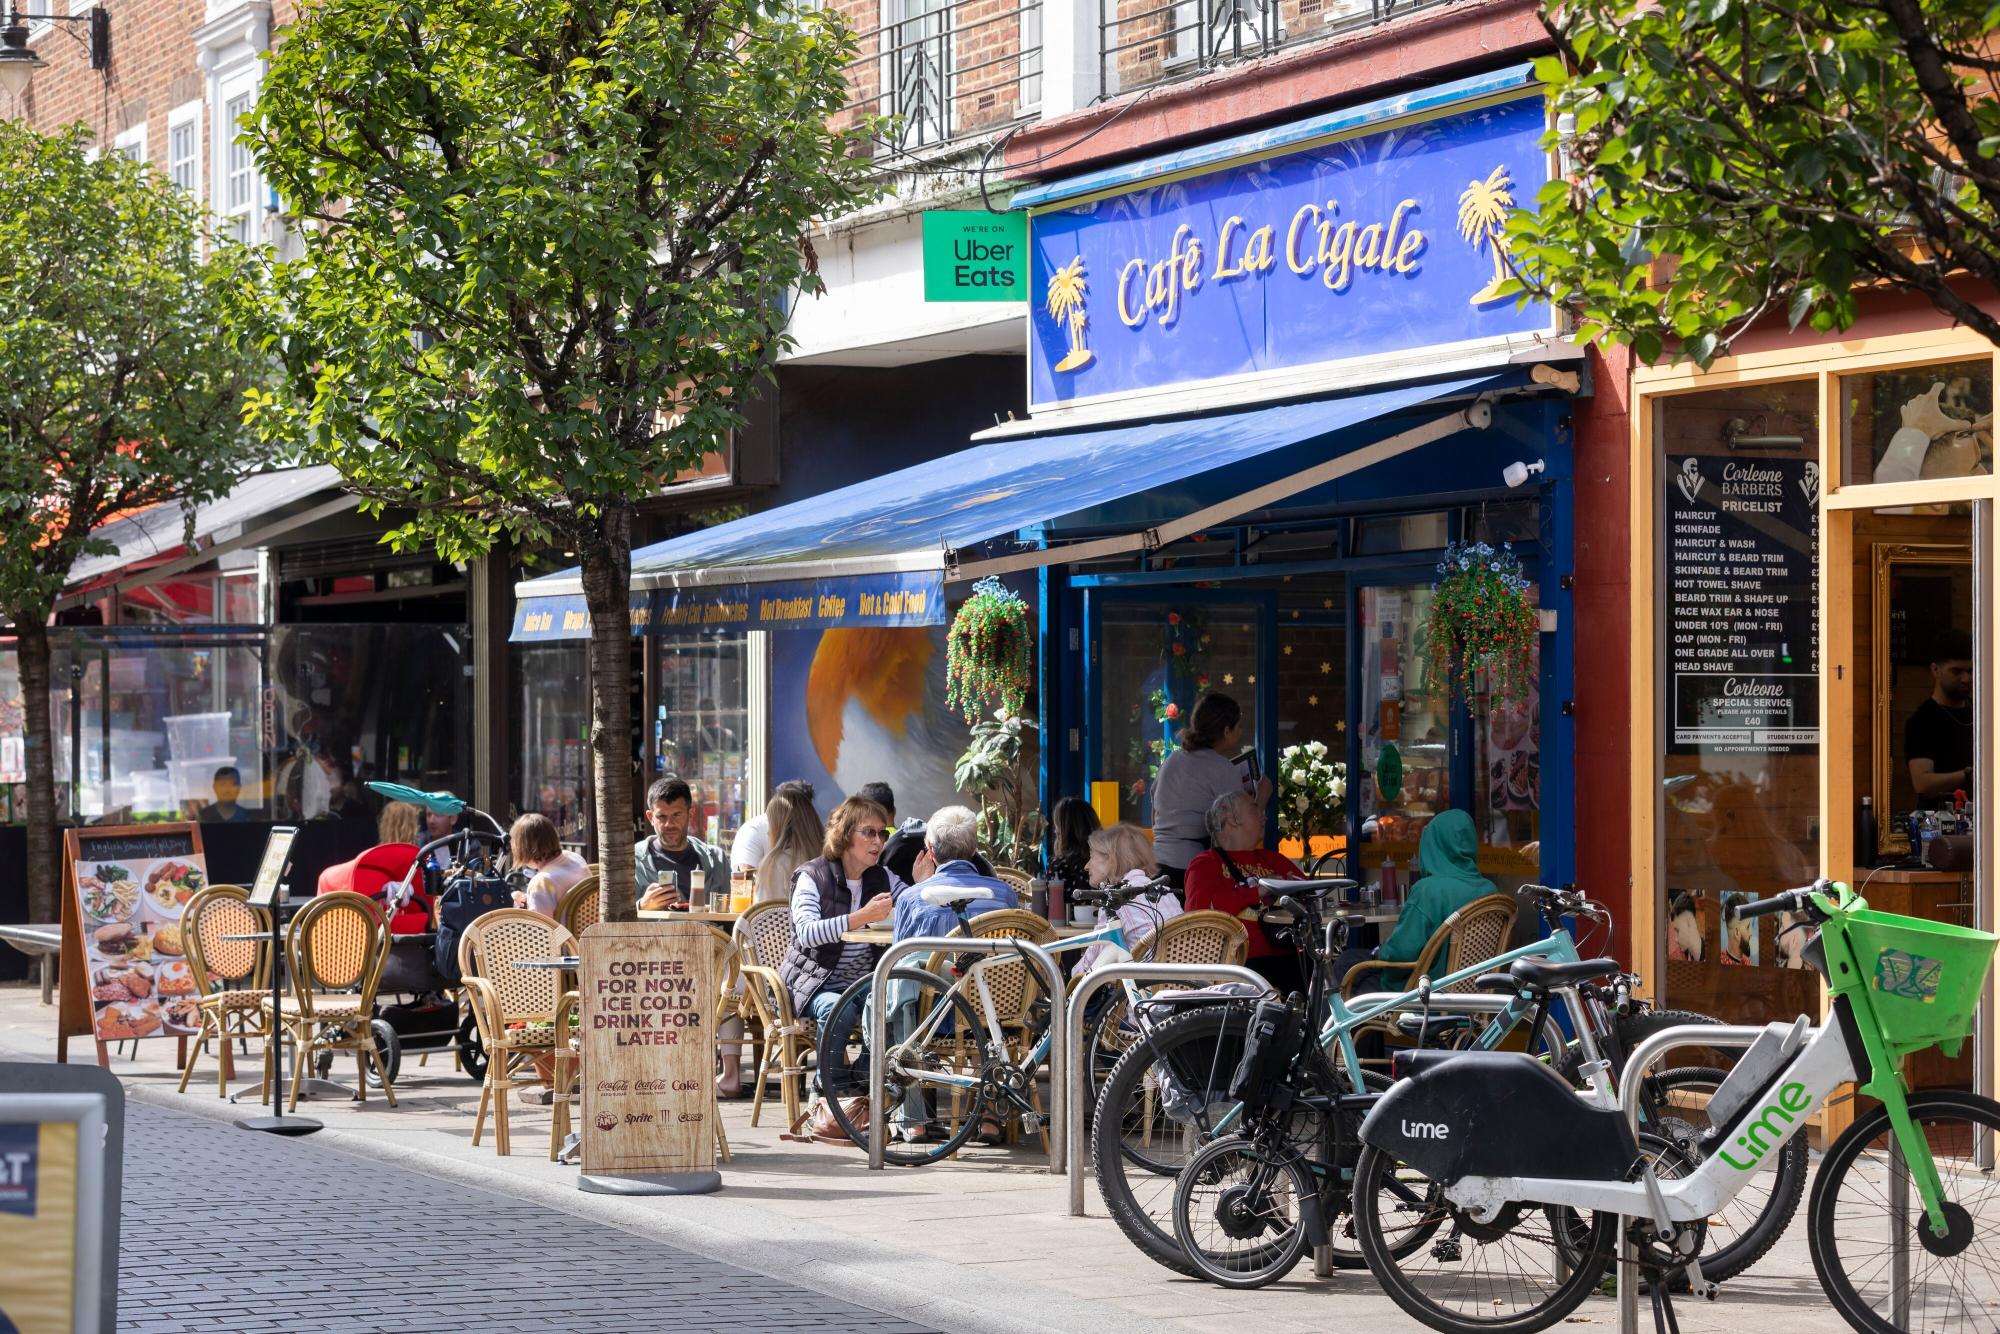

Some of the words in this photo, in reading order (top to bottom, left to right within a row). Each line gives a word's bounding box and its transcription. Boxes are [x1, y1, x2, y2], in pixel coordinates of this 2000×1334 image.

[954, 240, 1014, 261] Uber
[1118, 223, 1200, 326] Café
[1211, 216, 1272, 280] La
[1286, 199, 1424, 289] Cigale
[955, 265, 1015, 287] Eats
[1722, 462, 1784, 482] Corleone
[1722, 482, 1782, 496] BARBERS
[1722, 501, 1782, 513] PRICELIST
[1675, 511, 1716, 520] HAIRCUT
[1675, 525, 1721, 534] SKINFADE
[1675, 539, 1716, 548] HAIRCUT
[1719, 539, 1726, 548] &
[1728, 540, 1755, 548] WASH
[1675, 553, 1716, 561] HAIRCUT
[1719, 553, 1726, 562] &
[1728, 554, 1759, 562] BEARD
[1761, 554, 1784, 563] TRIM
[1675, 566, 1721, 575] SKINFADE
[1723, 567, 1730, 575] &
[1733, 567, 1763, 576] BEARD
[1766, 568, 1788, 576] TRIM
[1675, 580, 1695, 588] HOT
[1697, 580, 1729, 589] TOWEL
[1731, 581, 1761, 589] SHAVE
[859, 593, 875, 616] Hot
[875, 599, 881, 615] &
[883, 591, 903, 615] Cold
[903, 590, 926, 614] Food
[1675, 594, 1707, 602] BEARD
[1709, 594, 1732, 602] TRIM
[1734, 595, 1741, 603] &
[1744, 595, 1774, 603] SHAPE
[1776, 595, 1789, 603] UP
[704, 601, 749, 624] Sandwiches
[760, 599, 774, 621] Hot
[774, 597, 812, 620] Breakfast
[817, 594, 846, 618] Coffee
[1675, 607, 1698, 616] FACE
[1700, 608, 1722, 616] WAX
[1724, 608, 1742, 616] EAR
[1745, 608, 1752, 616] &
[1754, 608, 1779, 617] NOSE
[1675, 621, 1708, 630] UNDER
[1710, 621, 1729, 630] 10'S
[1734, 622, 1758, 631] (MON
[1765, 622, 1783, 631] FRI)
[1675, 635, 1694, 643] OAP
[1696, 635, 1720, 645] (MON
[1729, 636, 1747, 645] FRI)
[1675, 649, 1694, 657] ONE
[1697, 649, 1728, 657] GRADE
[1731, 649, 1748, 657] ALL
[1750, 650, 1775, 658] OVER
[1675, 662, 1700, 671] HEAD
[1703, 662, 1734, 671] SHAVE
[1723, 677, 1784, 697] Corleone
[1713, 698, 1751, 707] SPECIAL
[1754, 699, 1792, 707] SERVICE
[1744, 717, 1760, 726] £40
[609, 961, 684, 976] COFFEE
[597, 979, 637, 994] FOR
[645, 978, 696, 994] NOW,
[602, 996, 632, 1011] ICE
[640, 995, 692, 1011] COLD
[593, 1013, 654, 1029] DRINK
[661, 1012, 701, 1028] FOR
[616, 1031, 678, 1046] LATER
[672, 1080, 699, 1091] Coke
[625, 1113, 653, 1125] Sprite
[1719, 1082, 1812, 1170] Lime
[1402, 1119, 1450, 1139] Lime
[1118, 1200, 1134, 1217] XT3
[1132, 1219, 1155, 1240] COMP
